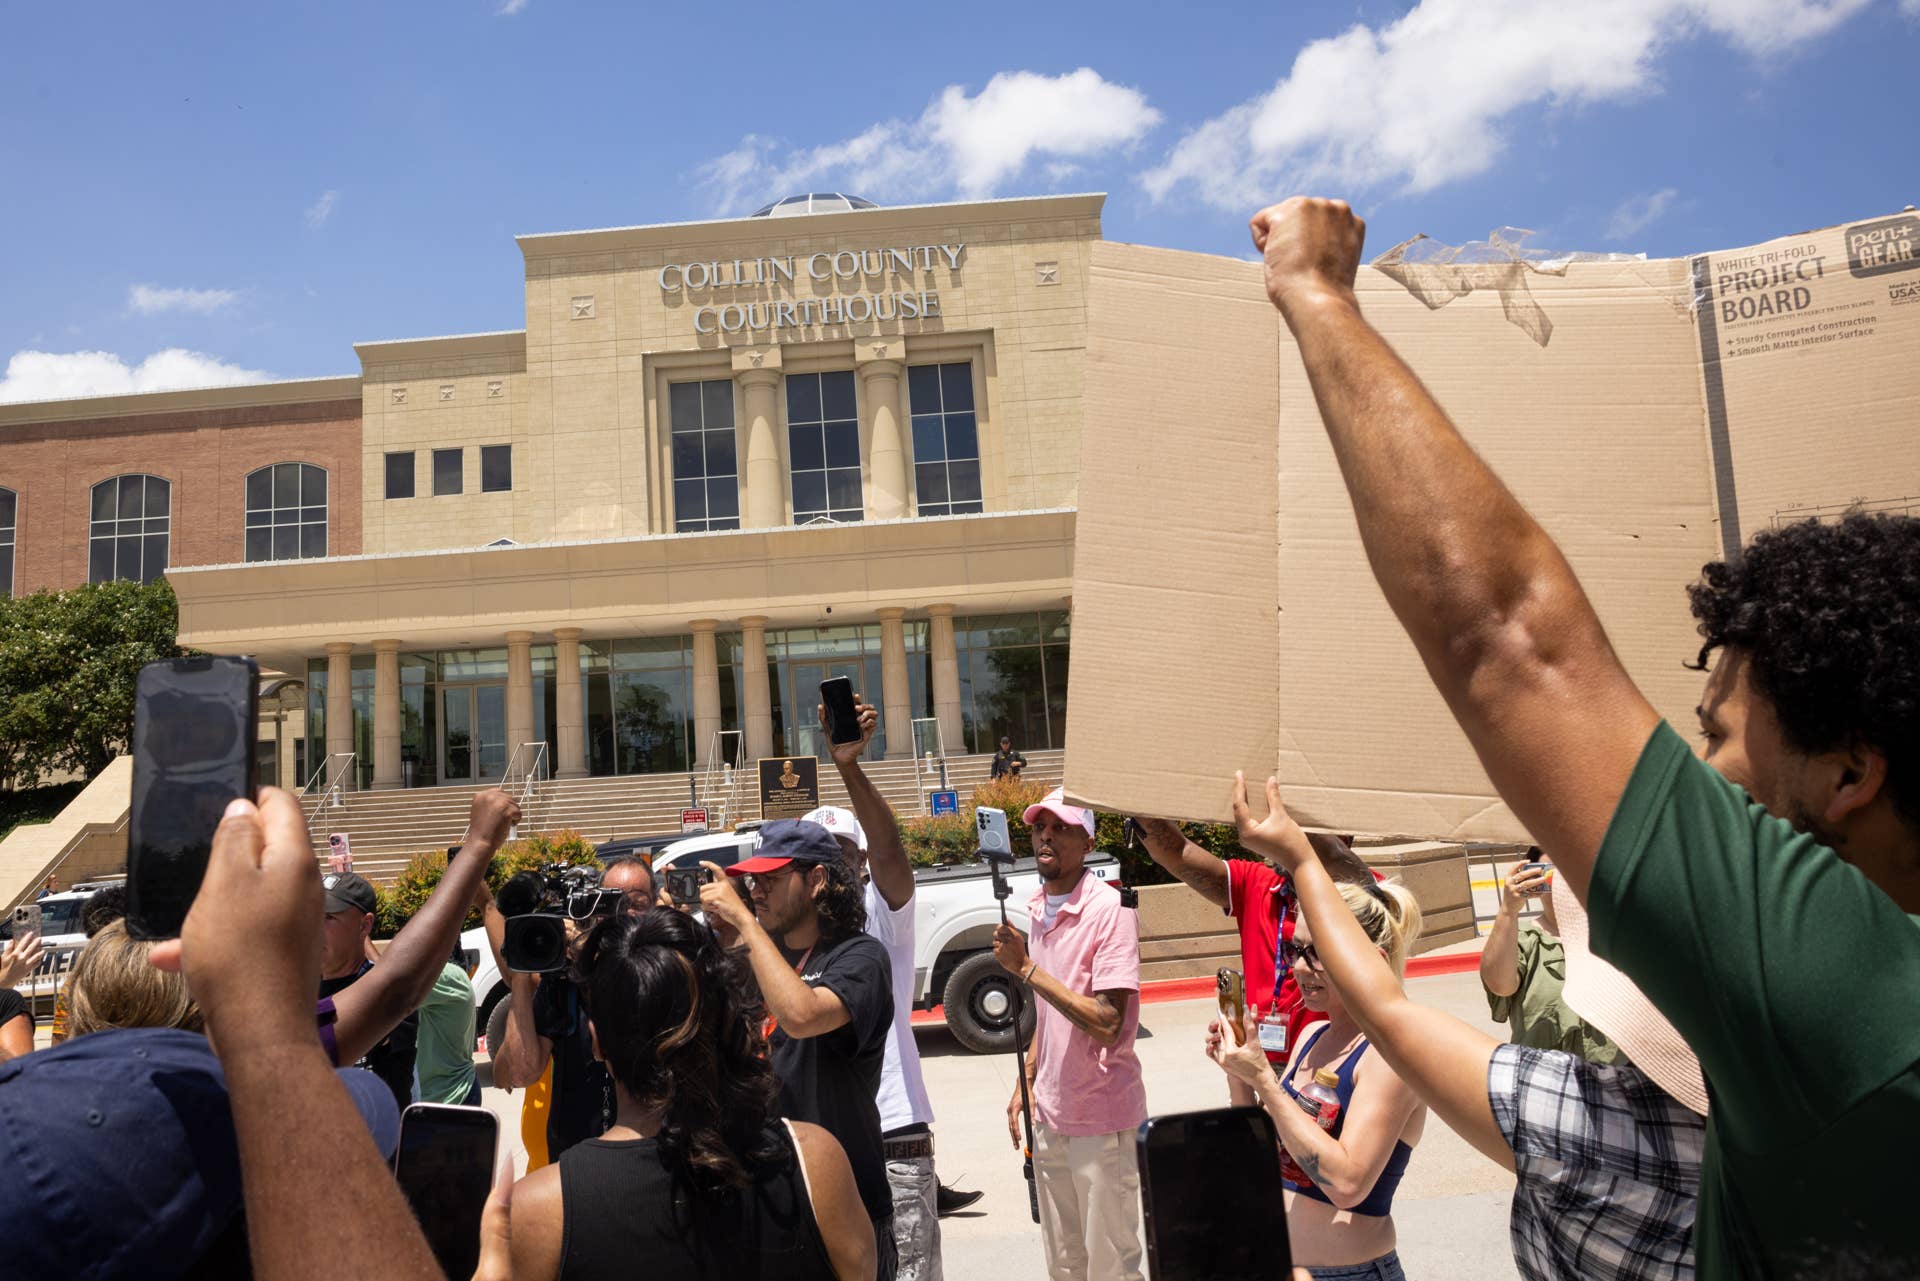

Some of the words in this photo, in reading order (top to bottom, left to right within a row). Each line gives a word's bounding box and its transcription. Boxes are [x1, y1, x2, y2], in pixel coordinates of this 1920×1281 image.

[658, 256, 795, 292] COLLIN
[808, 244, 965, 279] COUNTY
[1717, 256, 1756, 272] WHITE
[1759, 245, 1816, 264] TRI-FOLD
[1860, 240, 1914, 268] GEAR
[1718, 256, 1826, 296] PROJECT
[1721, 287, 1811, 323] BOARD
[1889, 288, 1917, 299] USA
[693, 290, 942, 334] COURTHOUSE
[1736, 334, 1764, 345] Sturdy
[1766, 325, 1816, 339] Corrugated
[1817, 316, 1877, 331] Construction
[1737, 344, 1771, 357] Smooth
[1773, 339, 1799, 350] Matte
[1801, 333, 1836, 345] Interior
[1838, 327, 1874, 339] Surface
